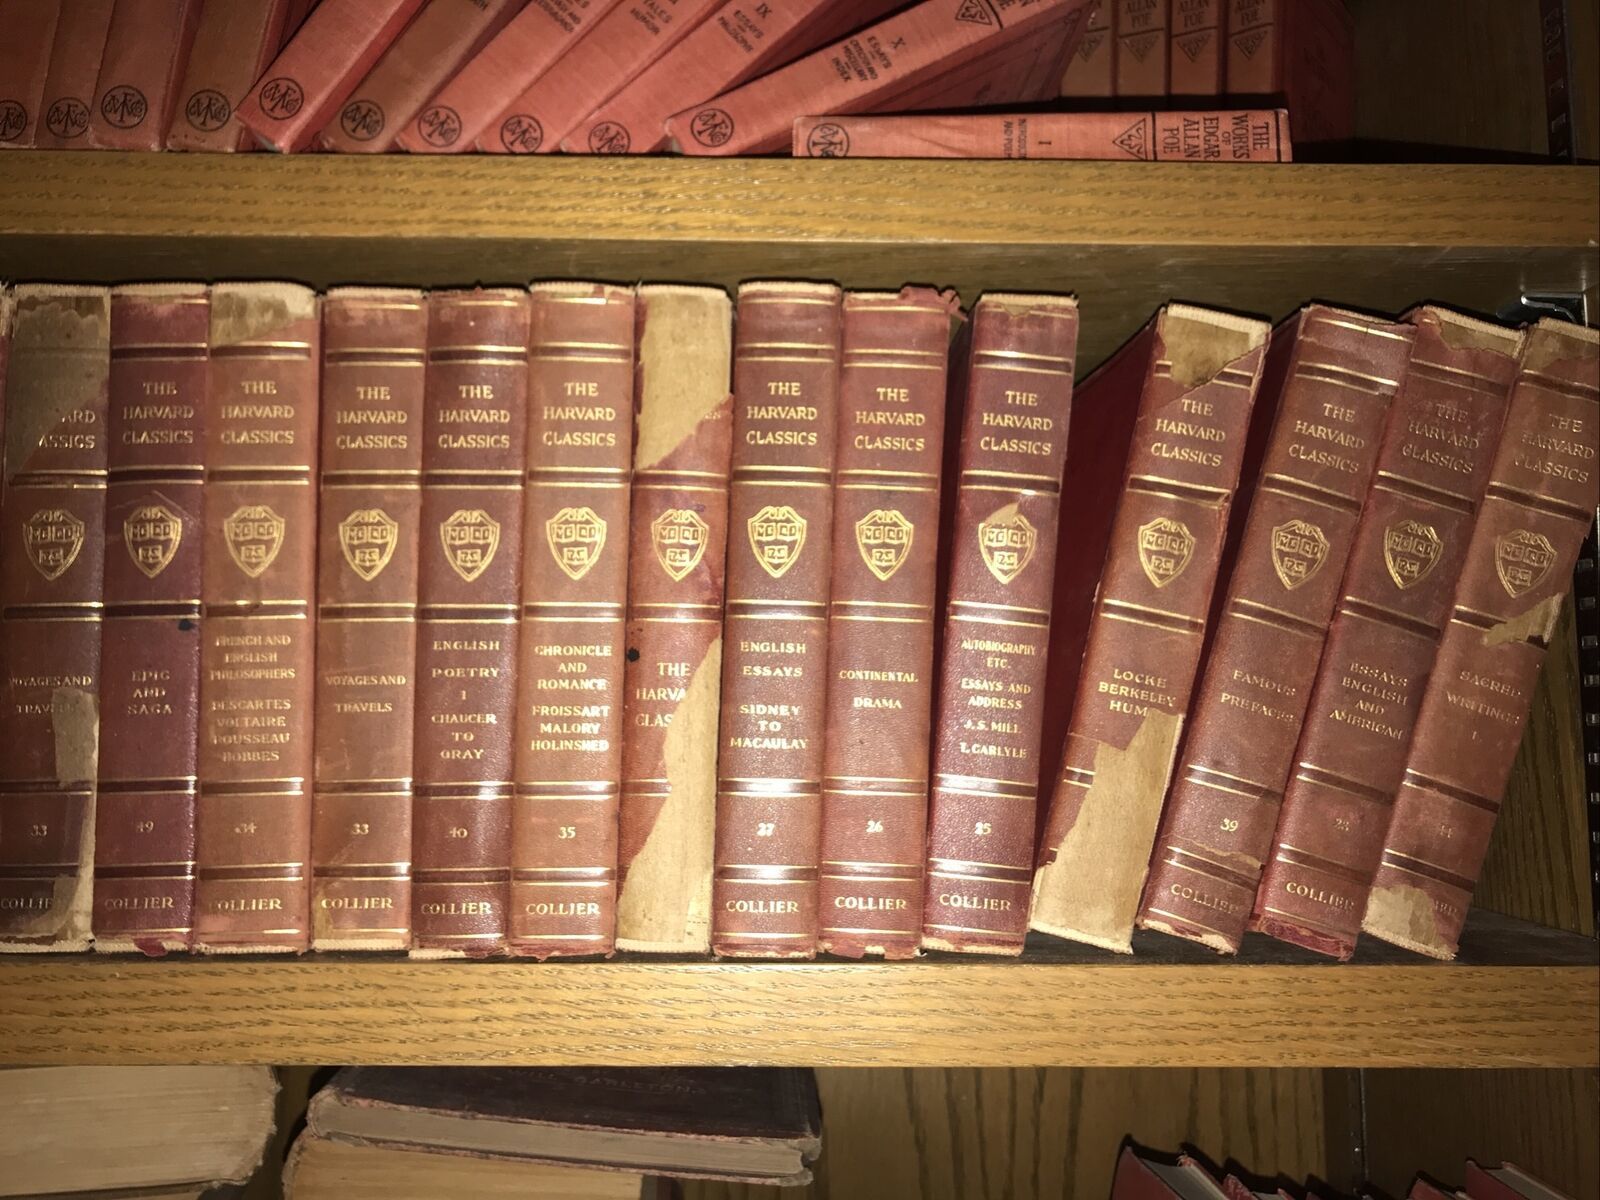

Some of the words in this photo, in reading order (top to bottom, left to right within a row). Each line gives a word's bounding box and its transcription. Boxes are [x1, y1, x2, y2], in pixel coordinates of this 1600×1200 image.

[755, 3, 773, 19] IX
[891, 36, 906, 49] X
[867, 36, 892, 69] ESSAYS
[832, 57, 851, 82] INDEX
[1163, 126, 1180, 154] POE
[1183, 116, 1201, 158] ALLAN
[1203, 116, 1220, 160] EDGAR
[1222, 131, 1231, 145] OF
[1232, 113, 1250, 159] WORKS
[1252, 121, 1270, 151] THE
[143, 382, 177, 395] THE
[241, 381, 277, 395] THE
[357, 387, 390, 400] THE
[459, 385, 493, 399] THE
[564, 382, 599, 396] THE
[768, 382, 801, 395] THE
[876, 387, 909, 402] THE
[1005, 391, 1038, 407] THE
[123, 405, 194, 419] HARVARD
[221, 404, 294, 419] HARVARD
[543, 407, 616, 421] HARVARD
[747, 406, 817, 420] HARVARD
[1181, 399, 1214, 417] THE
[1323, 403, 1356, 423] THE
[1435, 403, 1469, 423] THE
[336, 410, 407, 423] HARVARD
[438, 409, 510, 423] HARVARD
[855, 411, 925, 427] HARVARD
[982, 413, 1052, 431] HARVARD
[1155, 418, 1226, 443] HARVARD
[1549, 414, 1583, 433] THE
[122, 430, 193, 444] CLASSICS
[221, 430, 294, 444] CLASSICS
[336, 435, 407, 449] CLASSICS
[438, 434, 510, 448] CLASSICS
[543, 431, 616, 446] CLASSICS
[746, 431, 818, 446] CLASSICS
[1295, 420, 1365, 450] HARVARD
[1408, 420, 1479, 450] HARVARD
[38, 436, 95, 449] ASSICS
[854, 435, 925, 451] CLASSICS
[980, 437, 1051, 456] CLASSICS
[1522, 432, 1595, 460] HARVARD
[1151, 442, 1222, 467] CLASSICS
[1289, 444, 1359, 473] CLASSICS
[1402, 443, 1474, 474] CLASSICS
[1514, 454, 1589, 484] CLASSICS
[216, 635, 264, 647] FRENCH
[265, 635, 291, 645] AND
[433, 640, 500, 651] ENGLISH
[740, 641, 806, 654] ENGLISH
[961, 639, 1036, 655] AUTOBIOGRAPHY
[225, 652, 278, 663] ENGLISH
[534, 645, 612, 656] CHRONICLE
[210, 668, 295, 680] PHILOSOPHERS
[432, 667, 500, 678] POETRY
[558, 663, 587, 673] AND
[657, 662, 691, 677] THE
[743, 666, 802, 677] ESSAYS
[1350, 662, 1408, 687] ESSAYS
[62, 675, 92, 686] AND
[132, 670, 170, 682] EPIC
[325, 675, 378, 686] VOYAGES
[379, 675, 406, 685] AND
[839, 670, 918, 683] CONTINENTAL
[1113, 668, 1168, 689] LOCKE
[1233, 670, 1296, 696] FAMOUS
[537, 679, 607, 691] ROMANCE
[961, 678, 1003, 691] ESSAYS
[1008, 684, 1031, 694] AND
[1460, 671, 1521, 697] SACRED
[133, 688, 166, 699] AND
[636, 688, 686, 701] HARVA
[1098, 682, 1176, 707] BERKELEY
[1342, 677, 1408, 706] ENGLISH
[127, 704, 172, 715] SAGA
[211, 699, 291, 711] DESCARTES
[334, 702, 393, 713] TRAVELS
[853, 697, 902, 709] DRAMA
[968, 696, 1022, 710] ADDRESS
[1110, 700, 1148, 717] HUM
[1220, 693, 1295, 722] PREFACES
[1355, 699, 1385, 715] AND
[1446, 691, 1520, 725] WRITINGS
[532, 705, 611, 717] FROISSART
[740, 705, 800, 716] SIDNEY
[216, 716, 286, 728] VOLTAIRE
[431, 713, 497, 725] CHAUCER
[635, 713, 673, 727] CLAS
[1329, 709, 1403, 740] AMERICAN
[540, 723, 601, 734] MALORY
[758, 721, 781, 732] TO
[991, 722, 1021, 734] MILL
[213, 733, 290, 745] ROUSSEAU
[452, 732, 474, 742] TO
[730, 737, 808, 749] MACAULAY
[531, 740, 609, 751] HOLINSHED
[223, 751, 280, 762] HOBBES
[440, 750, 484, 760] GRAY
[31, 825, 48, 837] 33
[235, 823, 257, 834] 34
[352, 823, 369, 835] 33
[757, 823, 775, 836] 27
[866, 821, 883, 833] 26
[975, 822, 992, 835] 25
[1220, 818, 1239, 832] 39
[558, 826, 576, 839] 35
[939, 894, 1011, 911] COLLIER
[1170, 883, 1239, 914] COLLIER
[1286, 881, 1354, 910] COLLIER
[1, 897, 50, 909] COLLI
[104, 897, 174, 910] COLLIER
[212, 898, 282, 910] OLLIER
[321, 898, 392, 909] COLLIER
[421, 902, 492, 915] COLLIER
[526, 903, 601, 915] COLLIER
[726, 900, 799, 913] COLLIER
[835, 896, 906, 910] COLLIER
